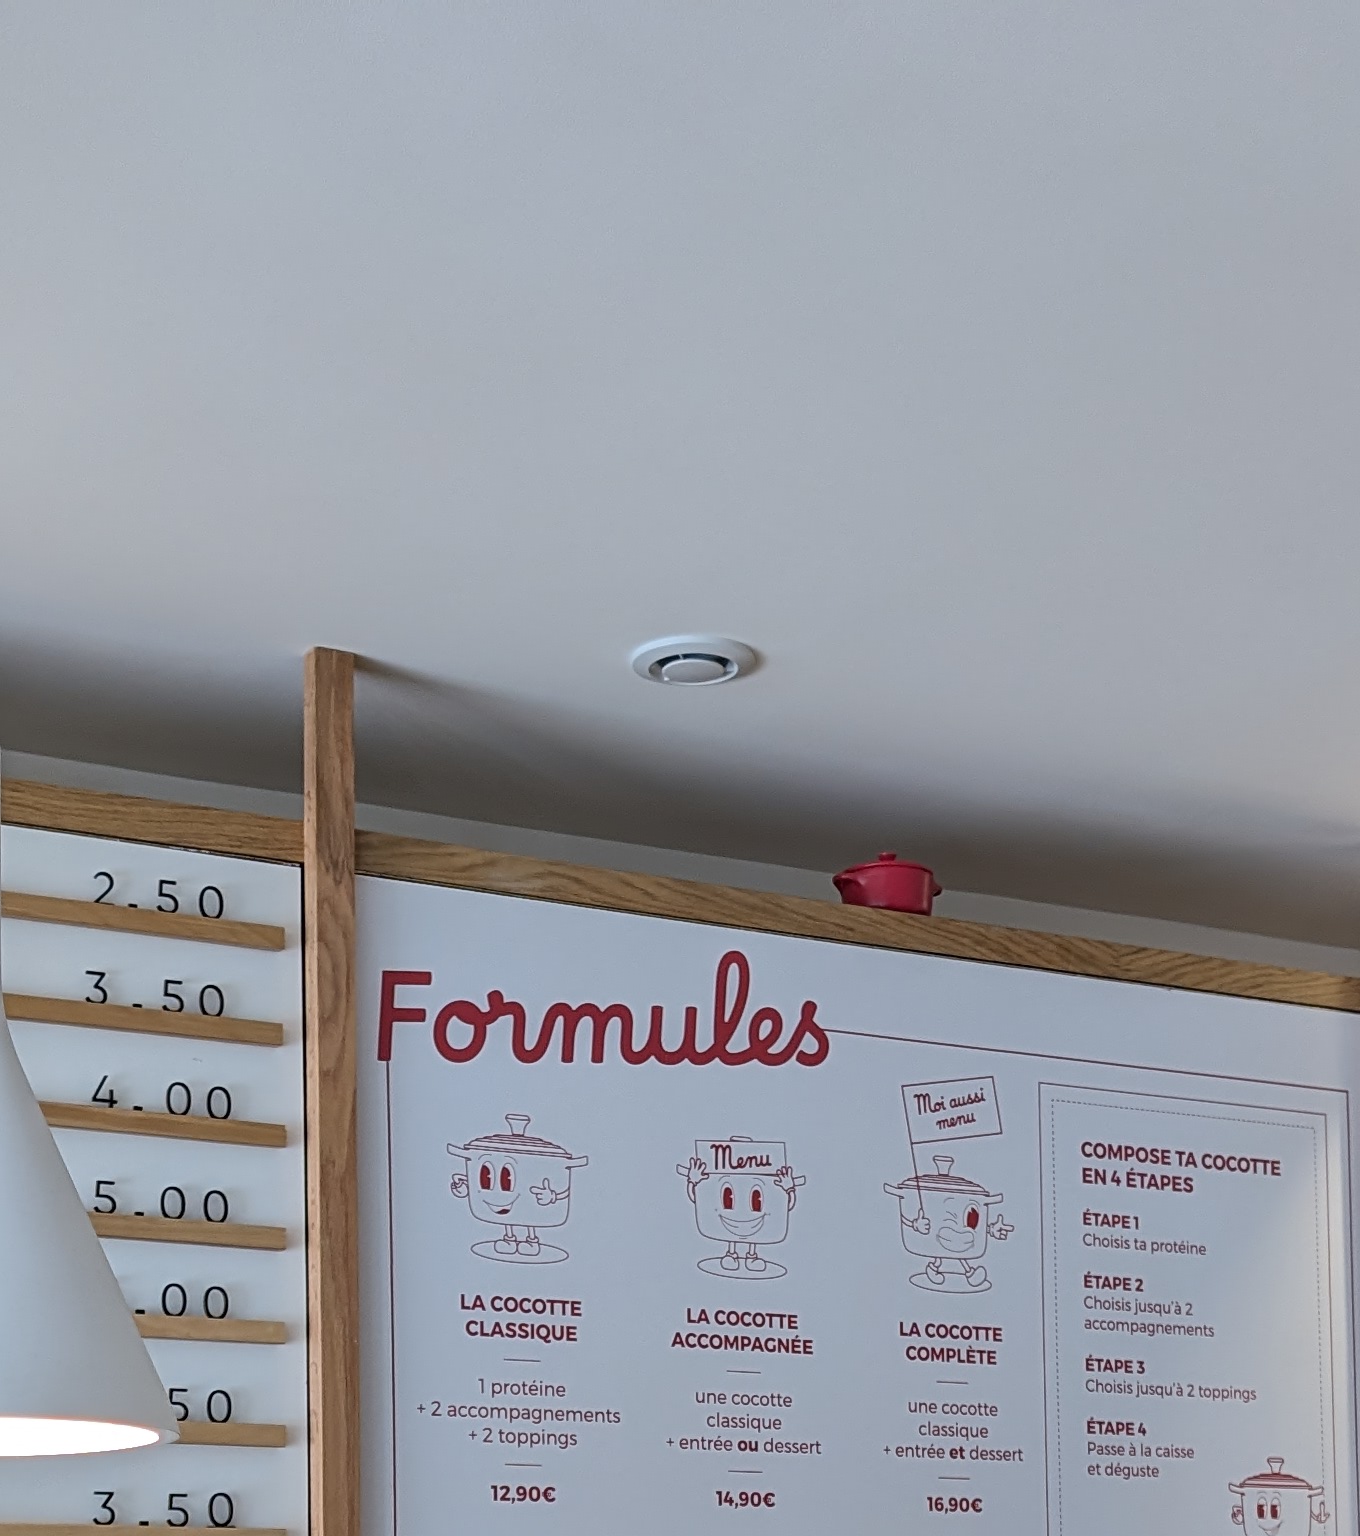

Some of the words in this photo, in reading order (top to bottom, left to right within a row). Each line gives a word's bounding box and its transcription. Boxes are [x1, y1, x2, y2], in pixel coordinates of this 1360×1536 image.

[92, 871, 225, 920] 2.50
[83, 970, 225, 1018] 3.50
[377, 950, 830, 1067] Formules
[91, 1075, 232, 1120] 4.00
[913, 1092, 946, 1115] Moi
[949, 1087, 987, 1111] aussi
[936, 1112, 976, 1130] menu
[710, 1143, 773, 1171] Menu
[1081, 1141, 1171, 1166] COMPOSE
[1175, 1150, 1197, 1169] TA
[1201, 1153, 1281, 1177] COCOTTE
[1081, 1167, 1108, 1185] EN
[1111, 1169, 1121, 1187] 4
[1126, 1167, 1194, 1193] ÉTAPES
[93, 1180, 229, 1224] 5.00
[1082, 1208, 1131, 1229] ÉTAPE
[1133, 1215, 1140, 1230] 1
[1082, 1232, 1130, 1250] Choisis
[1133, 1236, 1147, 1251] ta
[1150, 1237, 1207, 1256] protéine
[1083, 1271, 1131, 1291] ÉTAPE
[1134, 1278, 1144, 1292] 2
[133, 1283, 229, 1320] .00
[460, 1294, 486, 1312] LA
[490, 1295, 583, 1317] COCOTTE
[1083, 1295, 1131, 1312] Choisis
[1133, 1299, 1182, 1317] jusqu'à
[1185, 1303, 1193, 1316] 2
[686, 1308, 710, 1325] LA
[714, 1310, 799, 1330] COCOTTE
[1084, 1317, 1215, 1338] accompagnements
[465, 1320, 578, 1344] CLASSIQUE
[899, 1321, 922, 1338] LA
[924, 1323, 1003, 1342] COCOTTE
[671, 1332, 814, 1356] ACCOMPAGNÉE
[905, 1343, 997, 1366] COMPLÈTE
[1085, 1354, 1133, 1374] ÉTAPE
[1136, 1360, 1145, 1374] 3
[478, 1378, 486, 1394] 1
[491, 1379, 566, 1399] protéine
[695, 1390, 727, 1405] une
[731, 1390, 793, 1408] cocotte
[1085, 1379, 1133, 1395] Choisis
[1135, 1381, 1183, 1399] jusqu'à
[1186, 1383, 1195, 1398] 2
[1198, 1385, 1257, 1403] toppings
[416, 1403, 427, 1414] +
[431, 1401, 442, 1417] 2
[447, 1403, 621, 1424] accompagnements
[908, 1400, 938, 1415] une
[941, 1400, 998, 1417] cocotte
[706, 1412, 782, 1433] classique
[918, 1422, 989, 1442] classique
[1086, 1416, 1135, 1436] ÉTAPE
[1138, 1422, 1147, 1436] 4
[469, 1430, 478, 1440] +
[482, 1428, 494, 1444] 2
[498, 1429, 578, 1449] toppings
[665, 1437, 675, 1448] +
[679, 1436, 734, 1453] entrée
[737, 1440, 759, 1453] ou
[763, 1437, 822, 1455] dessert
[883, 1445, 892, 1455] +
[895, 1444, 945, 1460] entrée
[949, 1446, 965, 1460] et
[969, 1445, 1023, 1462] dessert
[1087, 1441, 1125, 1457] Passe
[1128, 1441, 1136, 1457] à
[1140, 1443, 1152, 1458] la
[1155, 1444, 1195, 1459] caisse
[1087, 1463, 1101, 1476] et
[1104, 1463, 1160, 1480] déguste
[490, 1485, 556, 1504] 12,90€
[716, 1490, 776, 1510] 14,90€
[927, 1496, 983, 1515] 16,90€
[92, 1490, 235, 1529] 3.50
